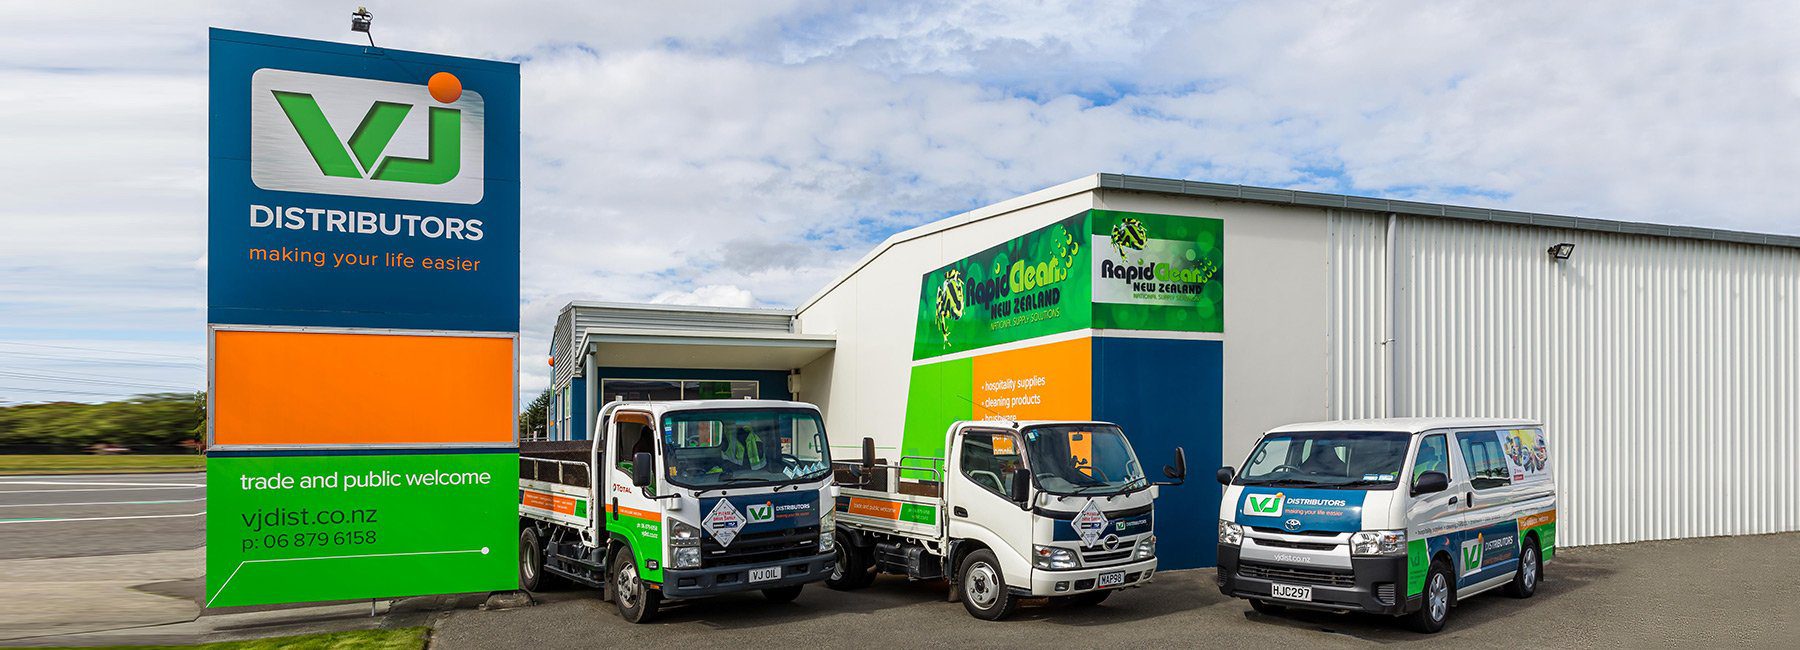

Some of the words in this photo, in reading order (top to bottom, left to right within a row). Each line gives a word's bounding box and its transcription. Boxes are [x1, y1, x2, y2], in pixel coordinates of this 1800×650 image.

[250, 204, 484, 241] DISTRIBUTORS
[249, 246, 326, 267] making
[333, 250, 378, 268] your
[386, 252, 415, 268] life
[422, 255, 481, 271] easier
[1133, 282, 1156, 292] NEW
[1159, 283, 1203, 294] ZEALAND
[991, 300, 1011, 319] NEW
[1014, 287, 1060, 314] ZEALAND
[1013, 315, 1030, 326] SUPPLY
[1031, 308, 1060, 323] SOLUTIONS
[985, 379, 1016, 392] hospitality
[1018, 375, 1046, 389] supplies
[985, 397, 1010, 408] cleaning
[1012, 394, 1041, 408] products
[240, 473, 294, 490] trade
[300, 472, 338, 489] and
[343, 470, 401, 491] public
[405, 469, 491, 487] welcome
[776, 503, 810, 512] DISTRIBUTORS
[1287, 498, 1346, 506] DISTRIBUTORS
[241, 507, 378, 532] vjdist.co.nz
[242, 536, 259, 552] p:
[263, 534, 289, 548] 06
[294, 532, 329, 547] 879
[334, 530, 377, 545] 6158
[1485, 535, 1513, 551] DISTRIBUTORS
[1274, 554, 1311, 563] vjdist.co.nz
[753, 570, 763, 580] VJ
[1273, 585, 1310, 598] HJC297
